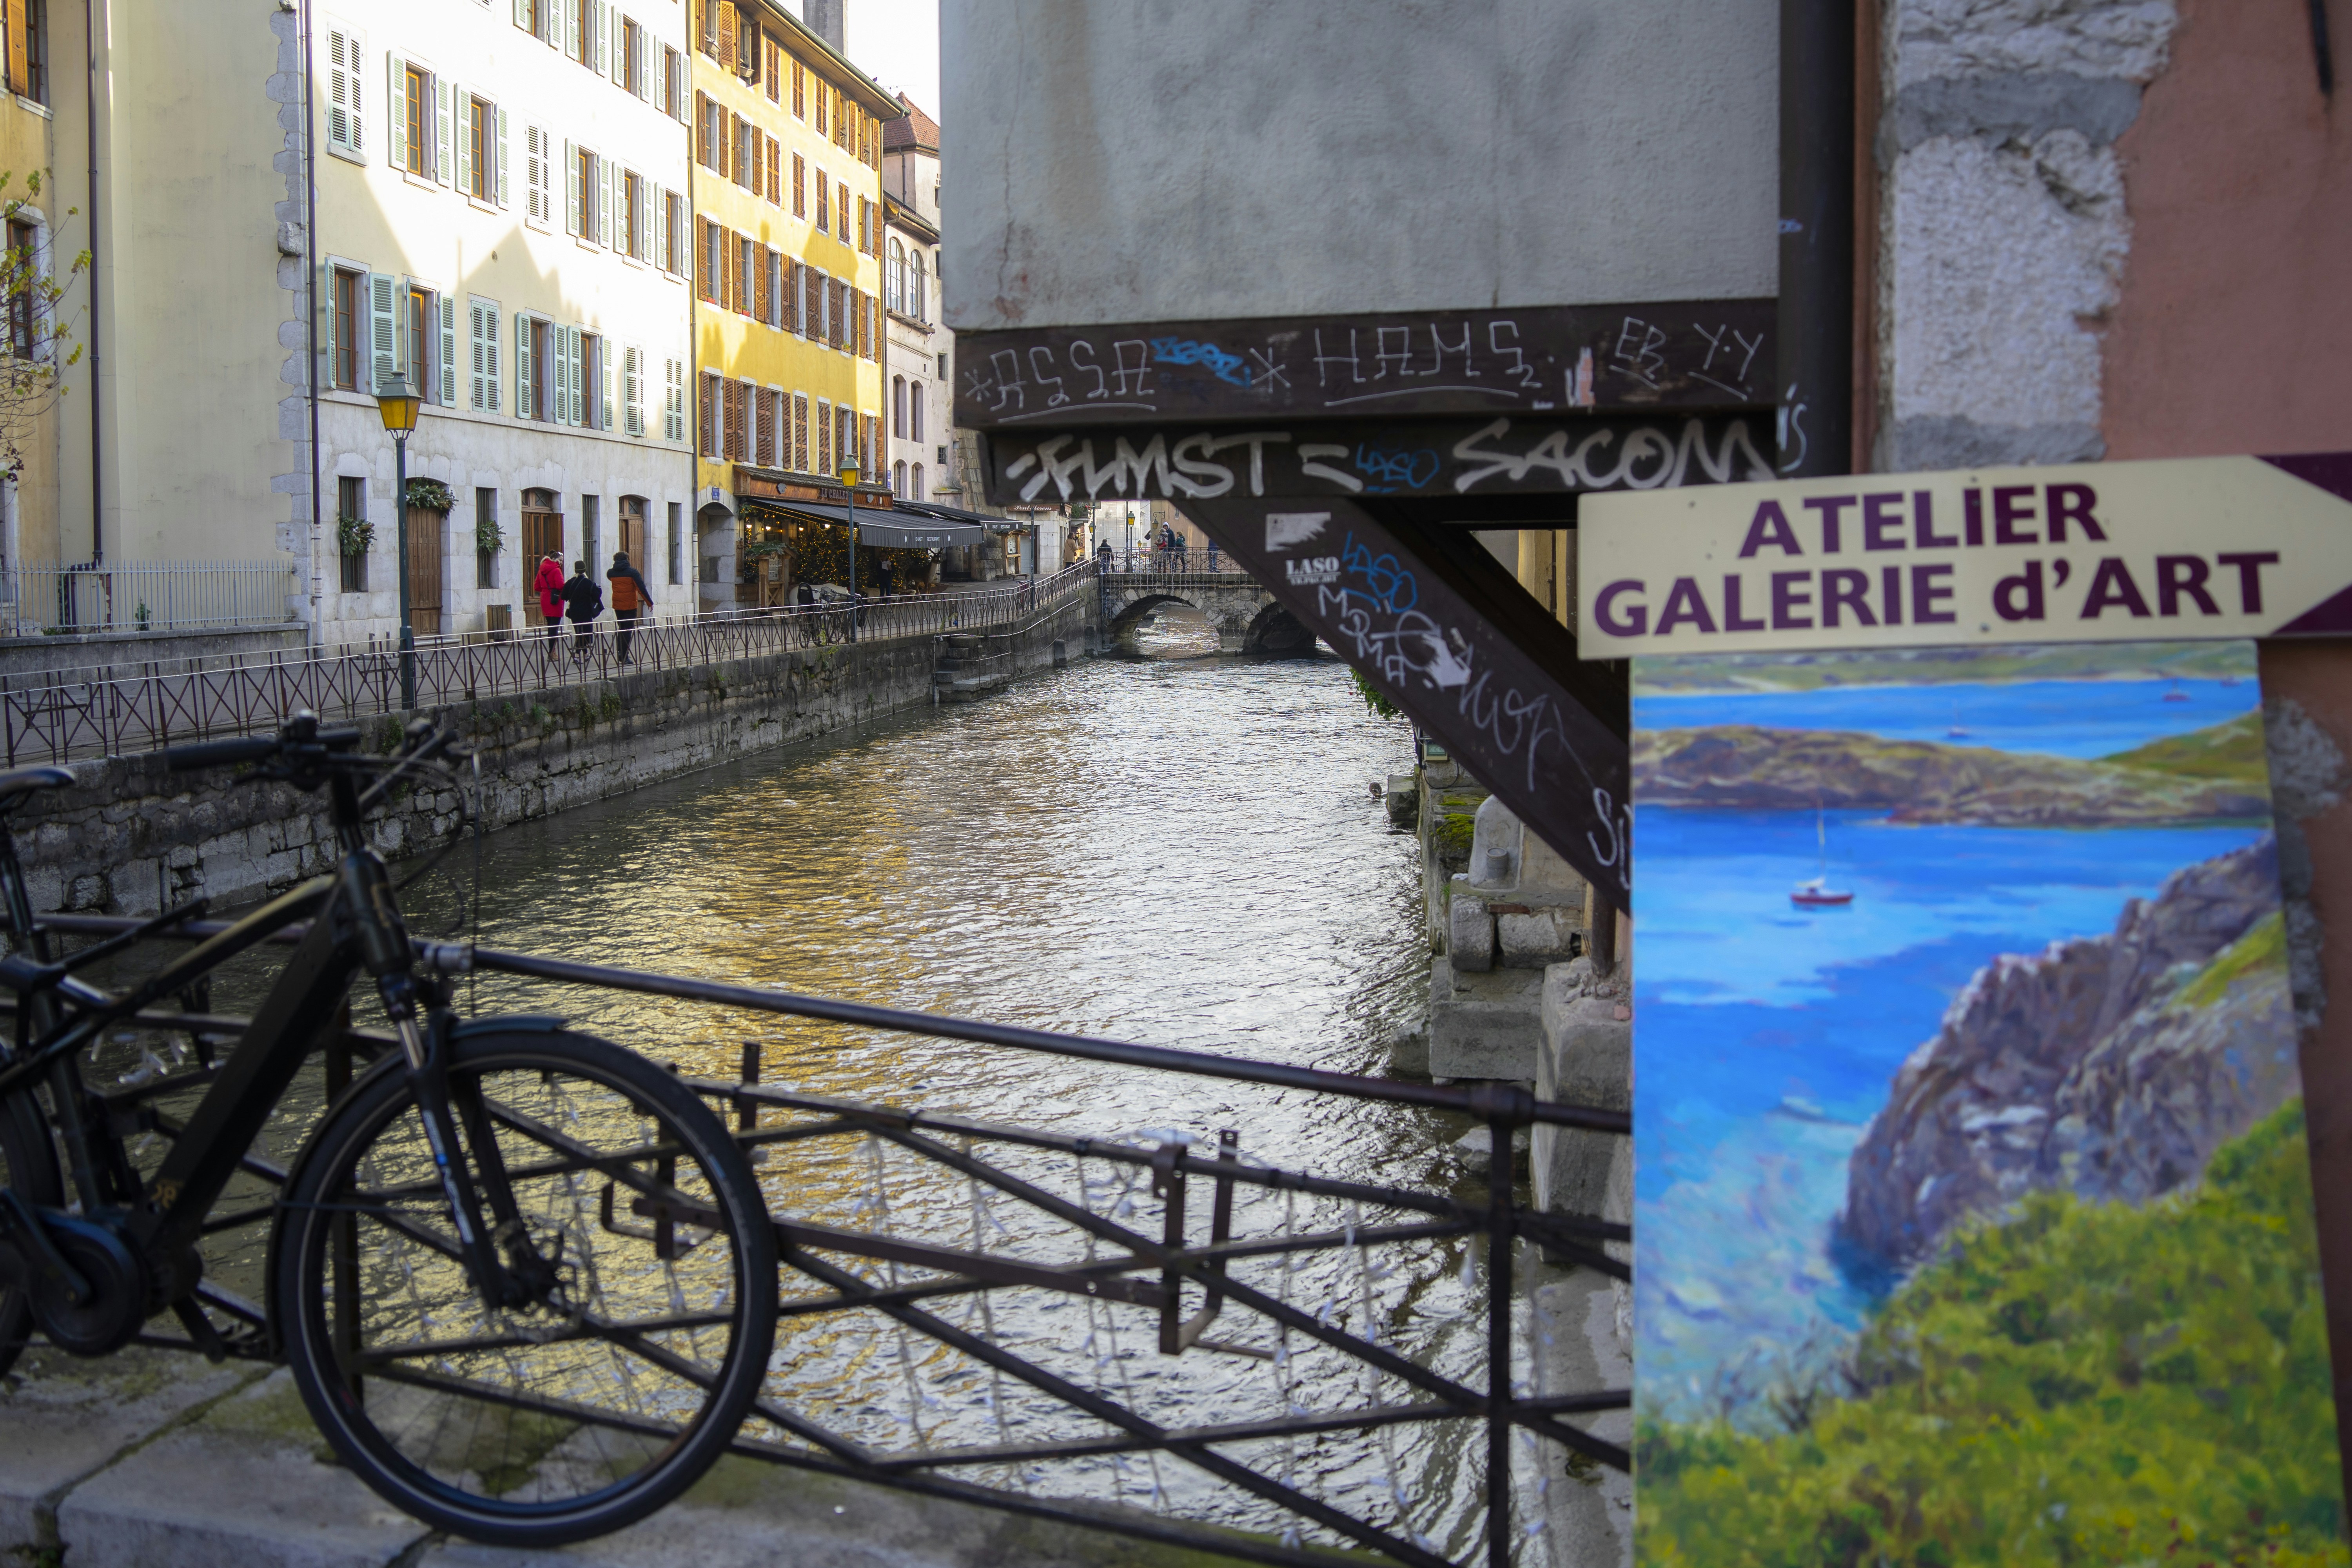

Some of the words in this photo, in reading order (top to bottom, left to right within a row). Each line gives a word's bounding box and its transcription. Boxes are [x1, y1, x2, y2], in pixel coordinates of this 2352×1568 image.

[822, 488, 828, 497] LE
[1737, 484, 2109, 558] ATELIER
[1285, 556, 1340, 575] LASO
[1594, 564, 1956, 637] GALERIE
[1993, 552, 2279, 621] d'ART
